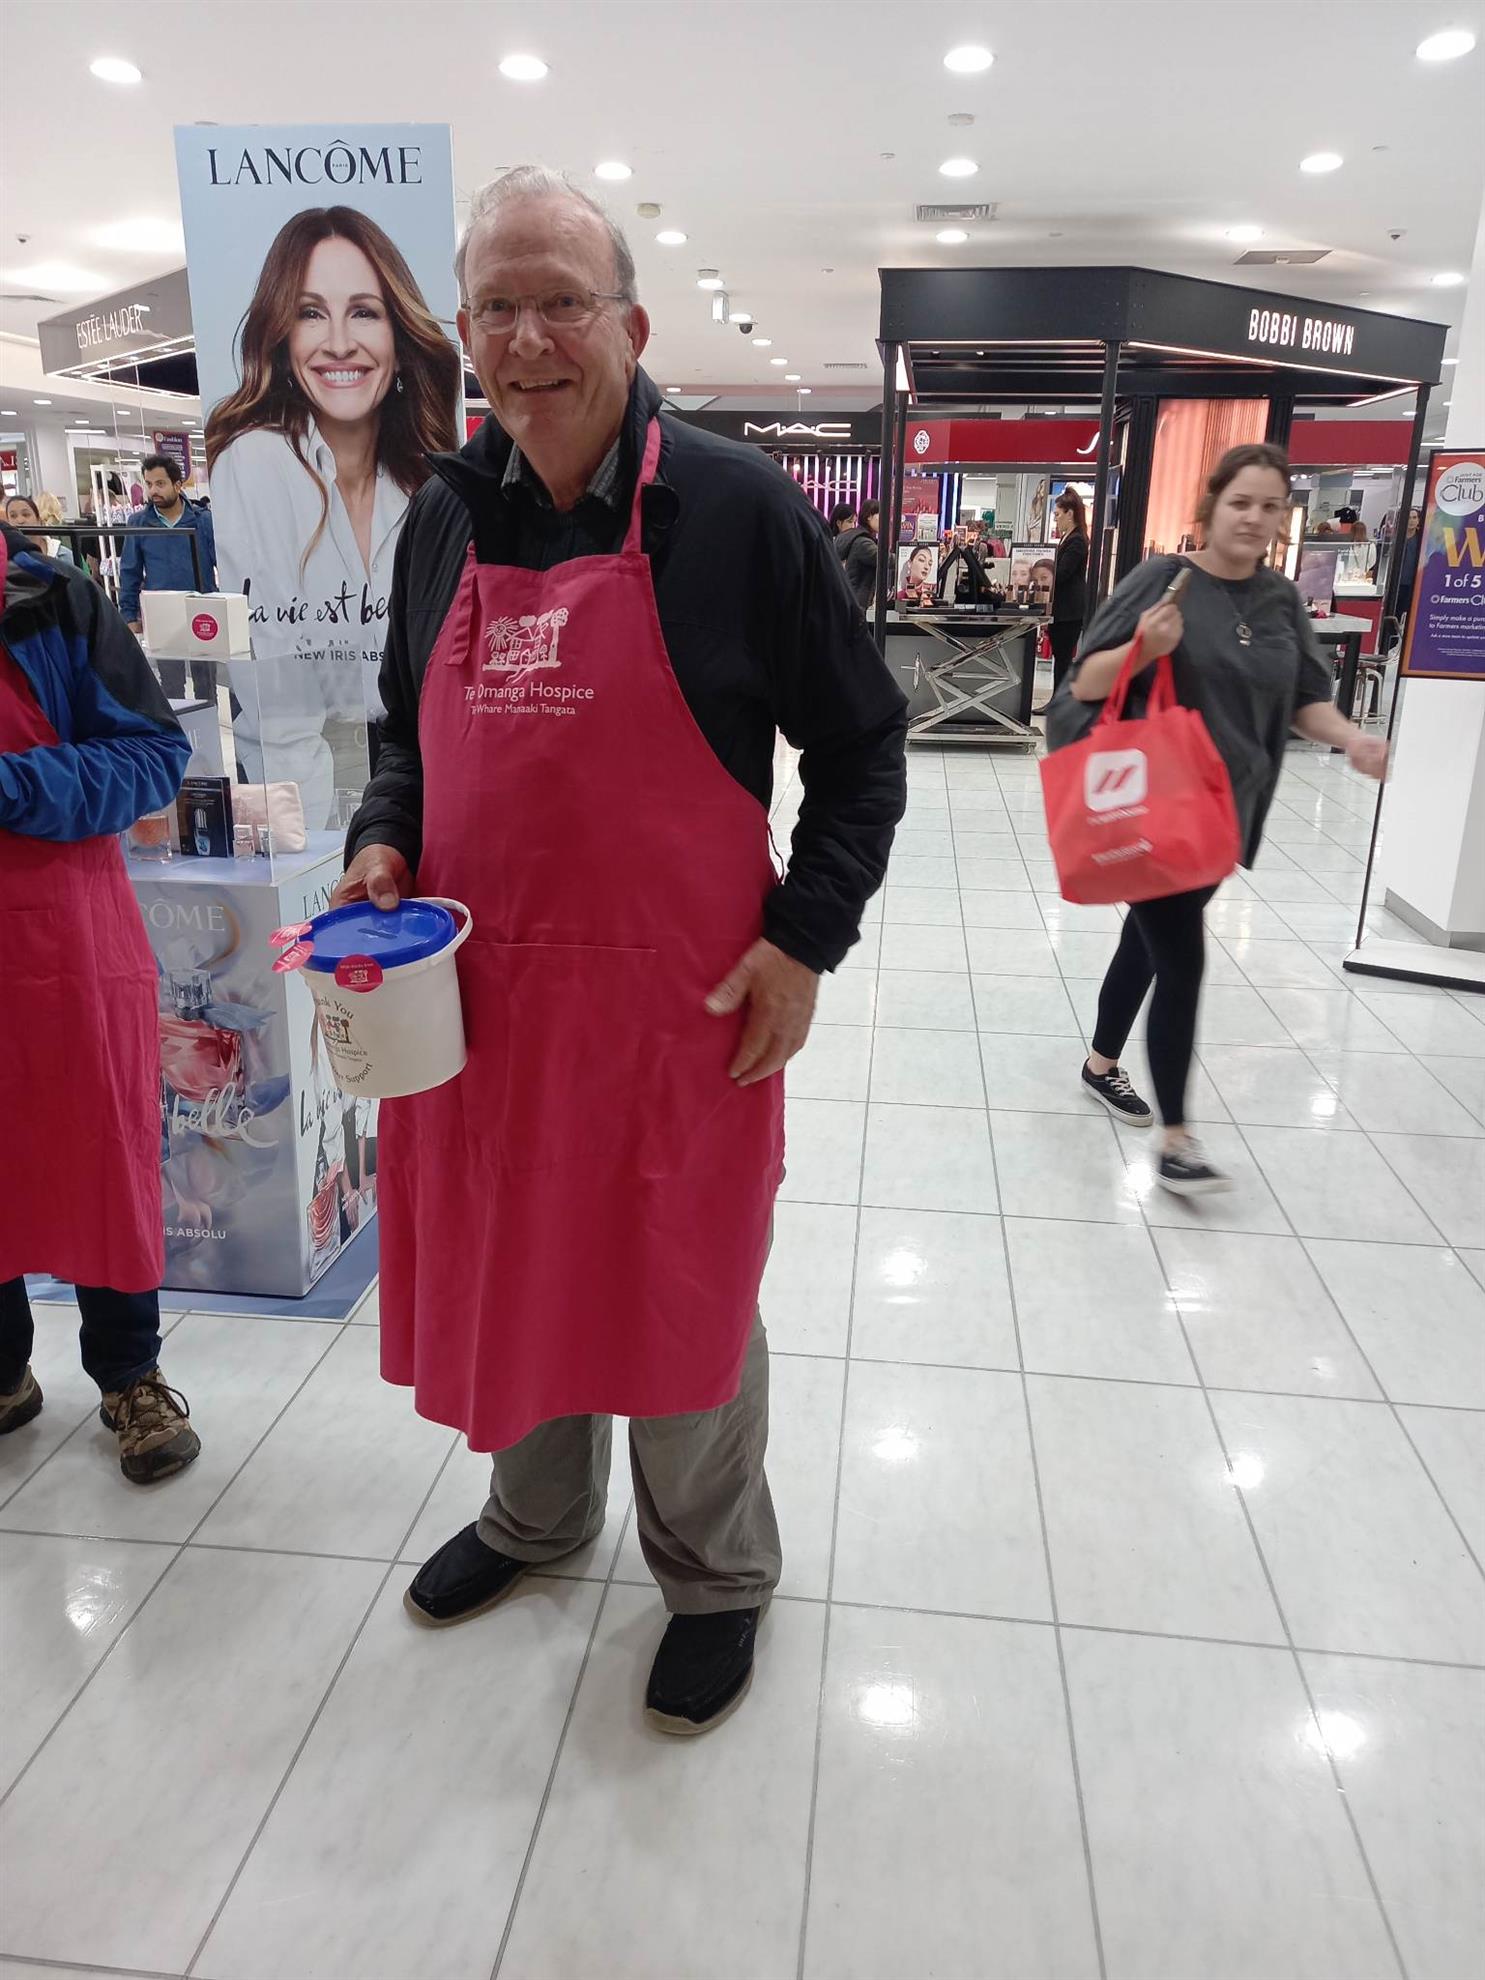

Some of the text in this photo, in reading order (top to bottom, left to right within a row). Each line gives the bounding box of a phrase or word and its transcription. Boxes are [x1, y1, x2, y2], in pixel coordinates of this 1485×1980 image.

[207, 139, 422, 185] LANCÔME
[103, 304, 143, 342] LAUDER
[1248, 308, 1355, 355] BOBBI BROWN
[1440, 484, 1484, 502] Club
[1444, 573, 1482, 588] 1 of 5
[277, 597, 309, 624] vie
[314, 580, 357, 623] est
[361, 583, 390, 625] be
[330, 650, 356, 661] IRIS
[464, 682, 594, 702] Te Omanga Hospice
[477, 704, 503, 714] Whare
[539, 703, 576, 717] Tangata
[333, 1001, 354, 1019] You
[341, 1046, 368, 1056] Hospice
[345, 1063, 373, 1083] Support
[172, 1082, 279, 1148] belle
[176, 1227, 227, 1239] ABSOLU
